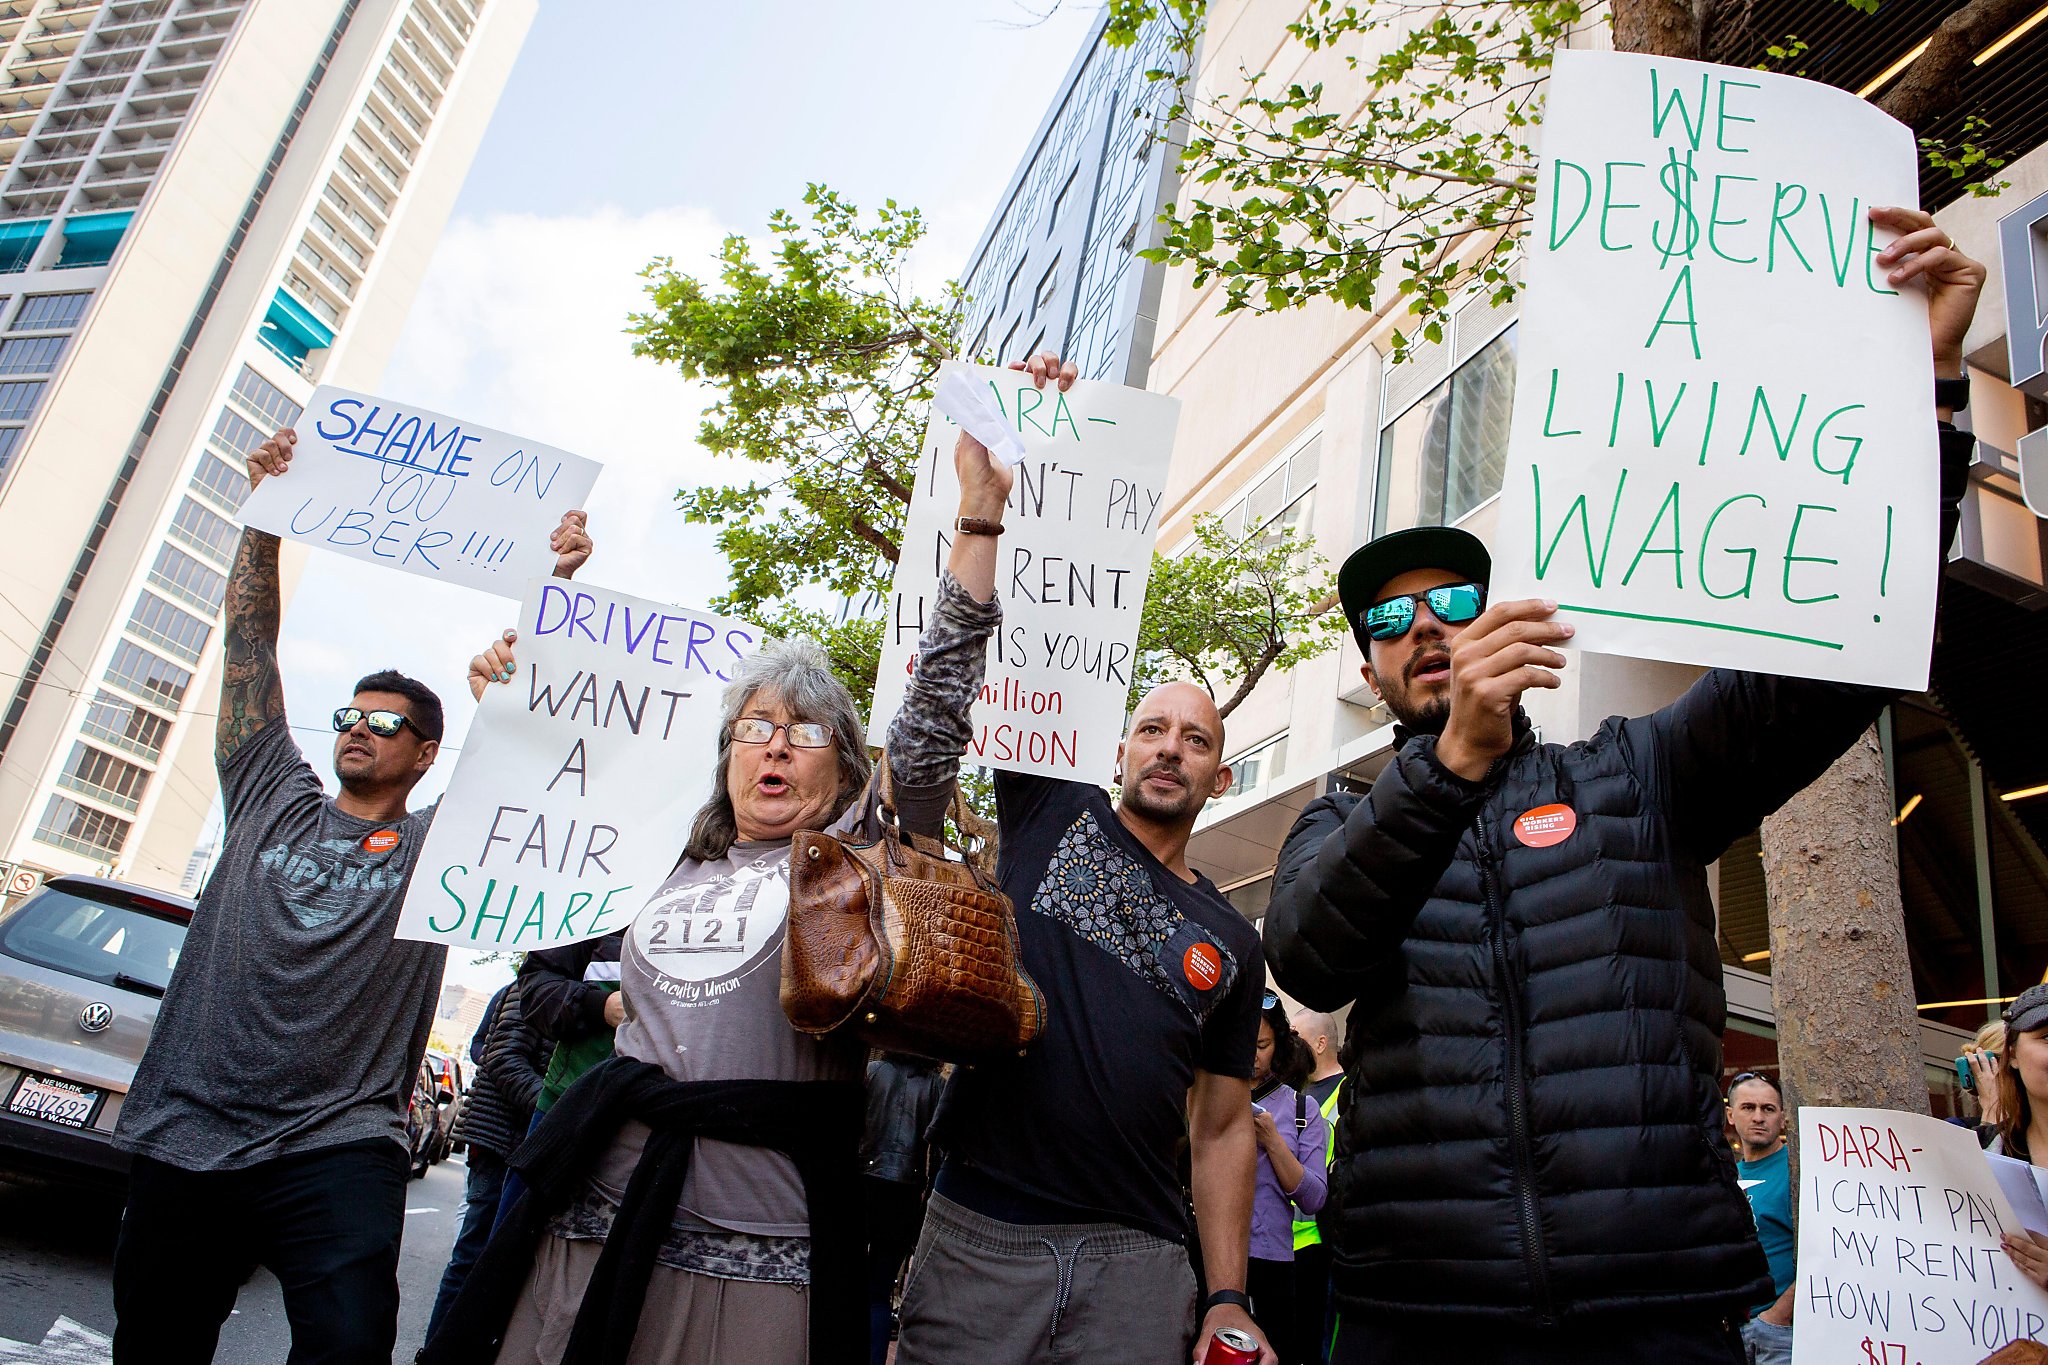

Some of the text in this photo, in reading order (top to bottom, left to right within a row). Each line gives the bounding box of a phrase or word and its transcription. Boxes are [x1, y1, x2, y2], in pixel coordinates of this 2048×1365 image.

[1650, 68, 1761, 153] WE
[1644, 264, 1701, 360] A
[316, 398, 562, 499] SHAME ON
[1543, 368, 1865, 486] LIVING
[369, 461, 457, 522] YOU
[1106, 478, 1162, 535] PAY
[290, 498, 514, 572] UBER!!!!
[1531, 463, 1895, 624] WAGE!
[1011, 547, 1131, 610] RENT.
[535, 585, 754, 683] DRIVERS
[997, 624, 1130, 687] IS YOUR
[529, 663, 692, 741] WANT
[546, 737, 586, 797] A
[964, 724, 1077, 768] NSION
[478, 806, 619, 878] FAIR
[1522, 815, 1565, 827] WORKERS
[1525, 823, 1555, 832] RISING
[428, 865, 634, 945] SHARE
[649, 916, 747, 945] 2121
[652, 972, 741, 1001] Faculty Union
[1190, 958, 1209, 975] RISING
[1192, 952, 1216, 975] WORKERS
[18, 1088, 89, 1121] 7GVZ692
[42, 1077, 83, 1093] NEWARK
[1817, 1123, 1923, 1172] DARA-
[1814, 1176, 2005, 1238] I CAN'T PAY
[1832, 1226, 2013, 1292] MY RENT.
[1809, 1274, 2045, 1350] HOW IS YOUR
